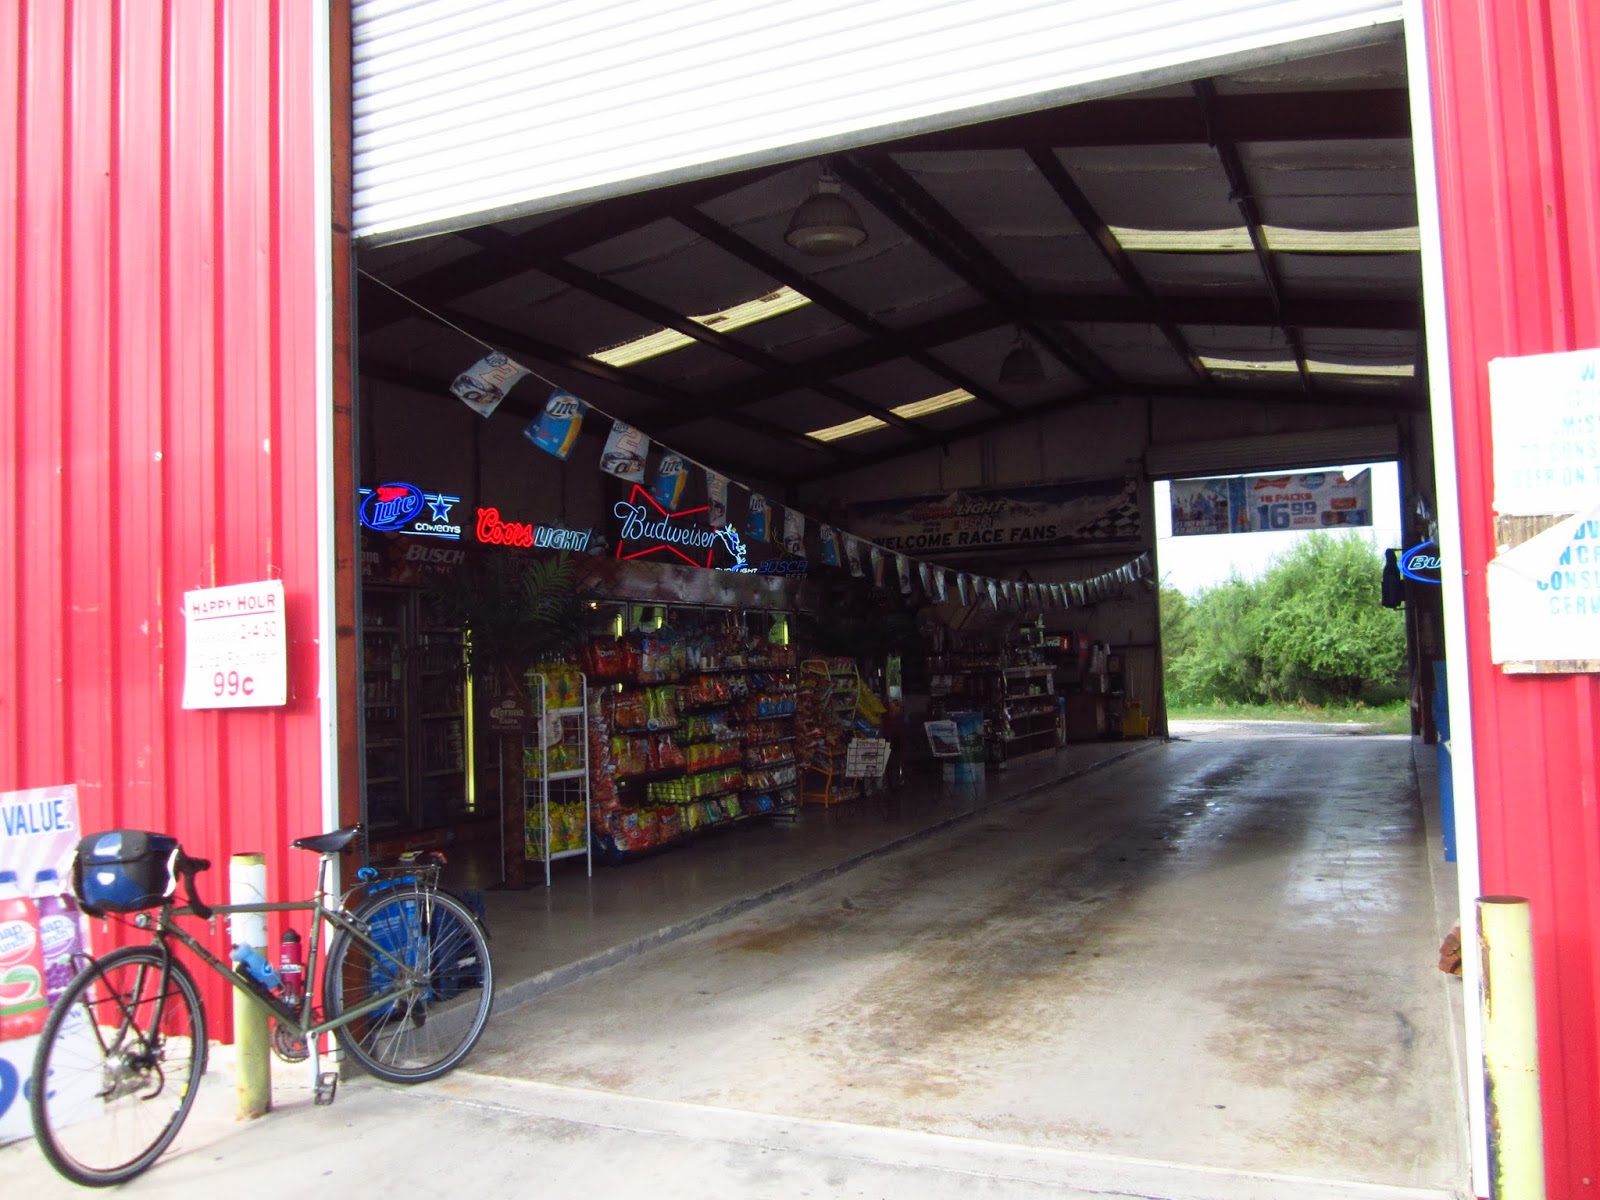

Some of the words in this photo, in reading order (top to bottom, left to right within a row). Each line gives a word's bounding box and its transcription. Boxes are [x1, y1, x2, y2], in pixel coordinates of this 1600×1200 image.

[549, 401, 578, 417] Lite
[371, 495, 417, 526] Lite
[415, 523, 461, 534] COWBOYS
[476, 507, 535, 549] Coors
[534, 525, 593, 552] LIGHT
[613, 501, 718, 548] Budweiser
[958, 528, 1005, 545] RACE
[1009, 524, 1057, 541] FANS
[405, 544, 466, 565] BUSCH
[758, 560, 809, 574] BUSCH
[192, 599, 233, 616] HAPPY
[238, 593, 277, 612] HOUR
